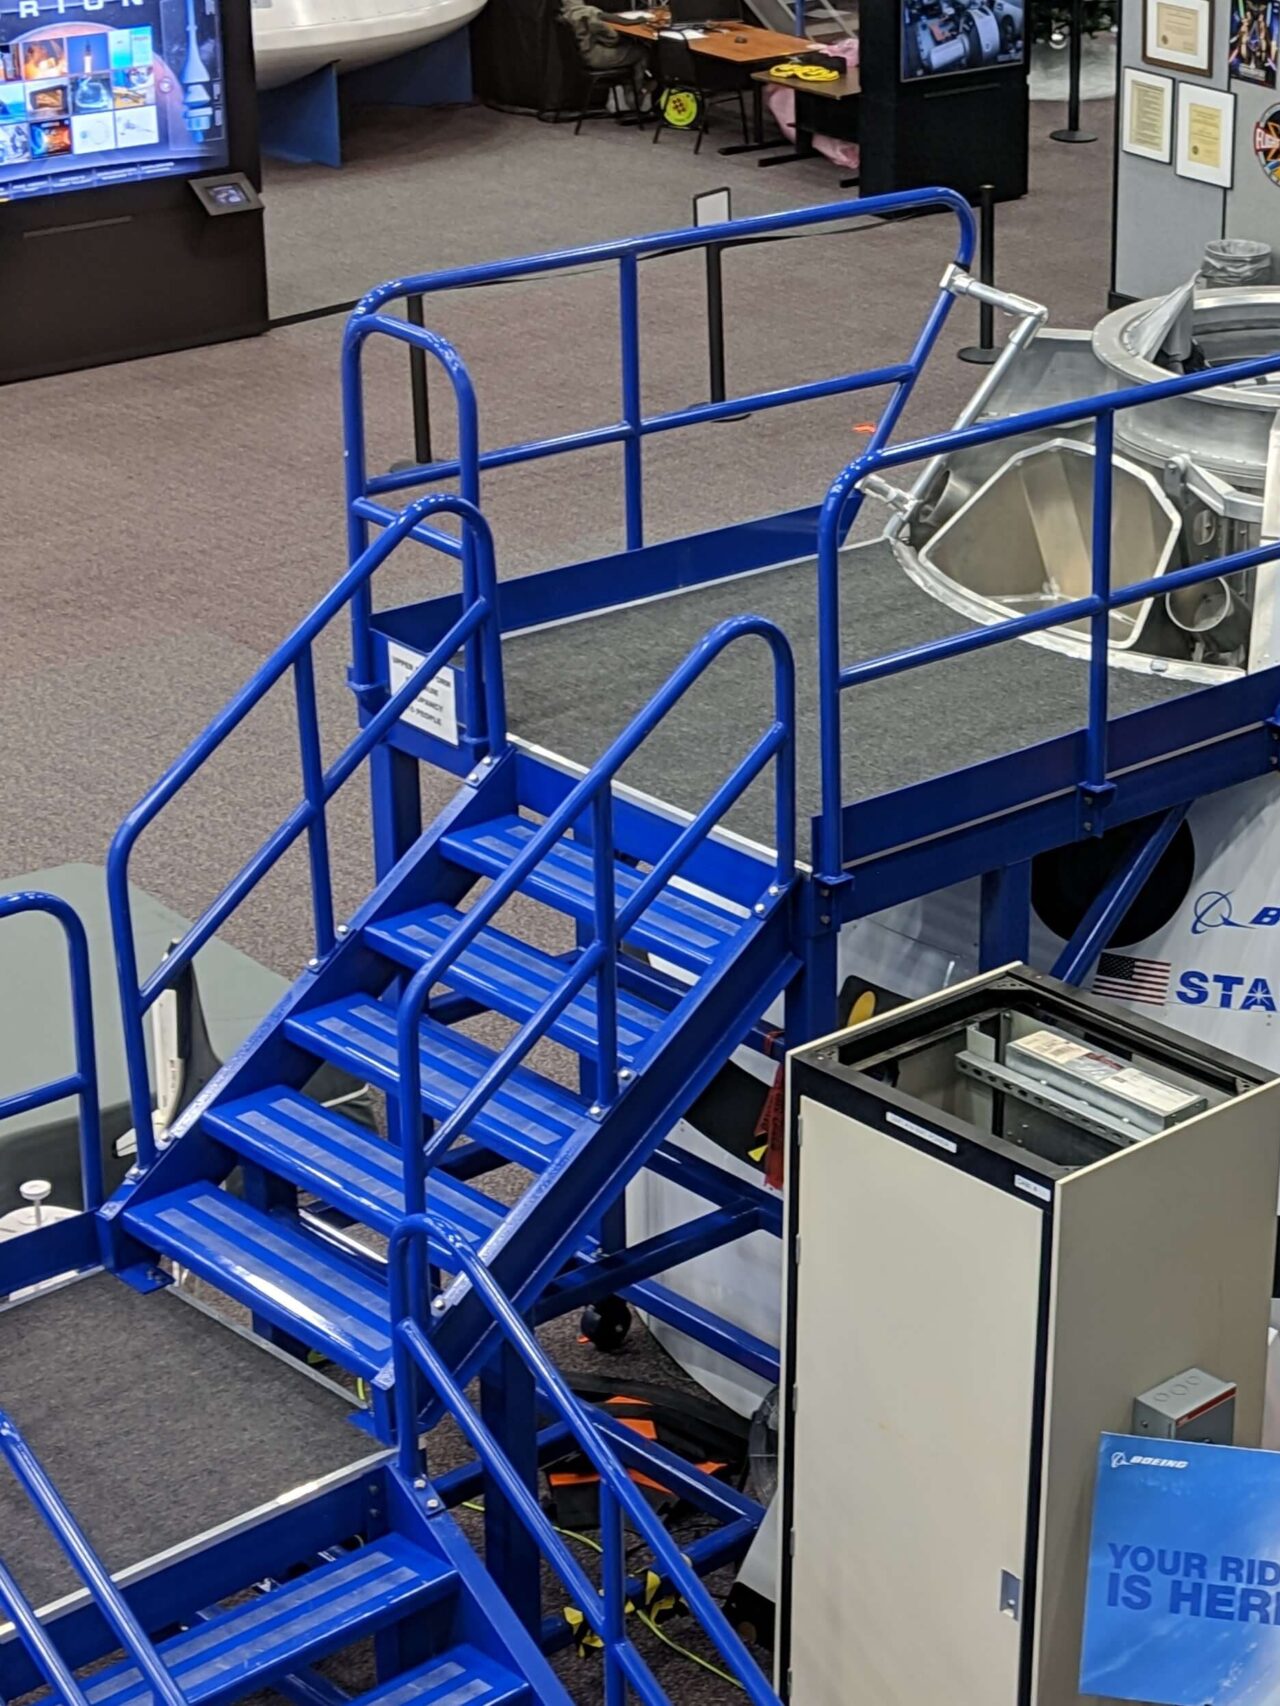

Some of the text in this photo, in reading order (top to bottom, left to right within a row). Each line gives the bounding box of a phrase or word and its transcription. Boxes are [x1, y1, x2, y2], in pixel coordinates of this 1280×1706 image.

[1130, 1455, 1189, 1469] BOEING
[1107, 1542, 1208, 1579] YOUR
[1106, 1572, 1152, 1610] IS
